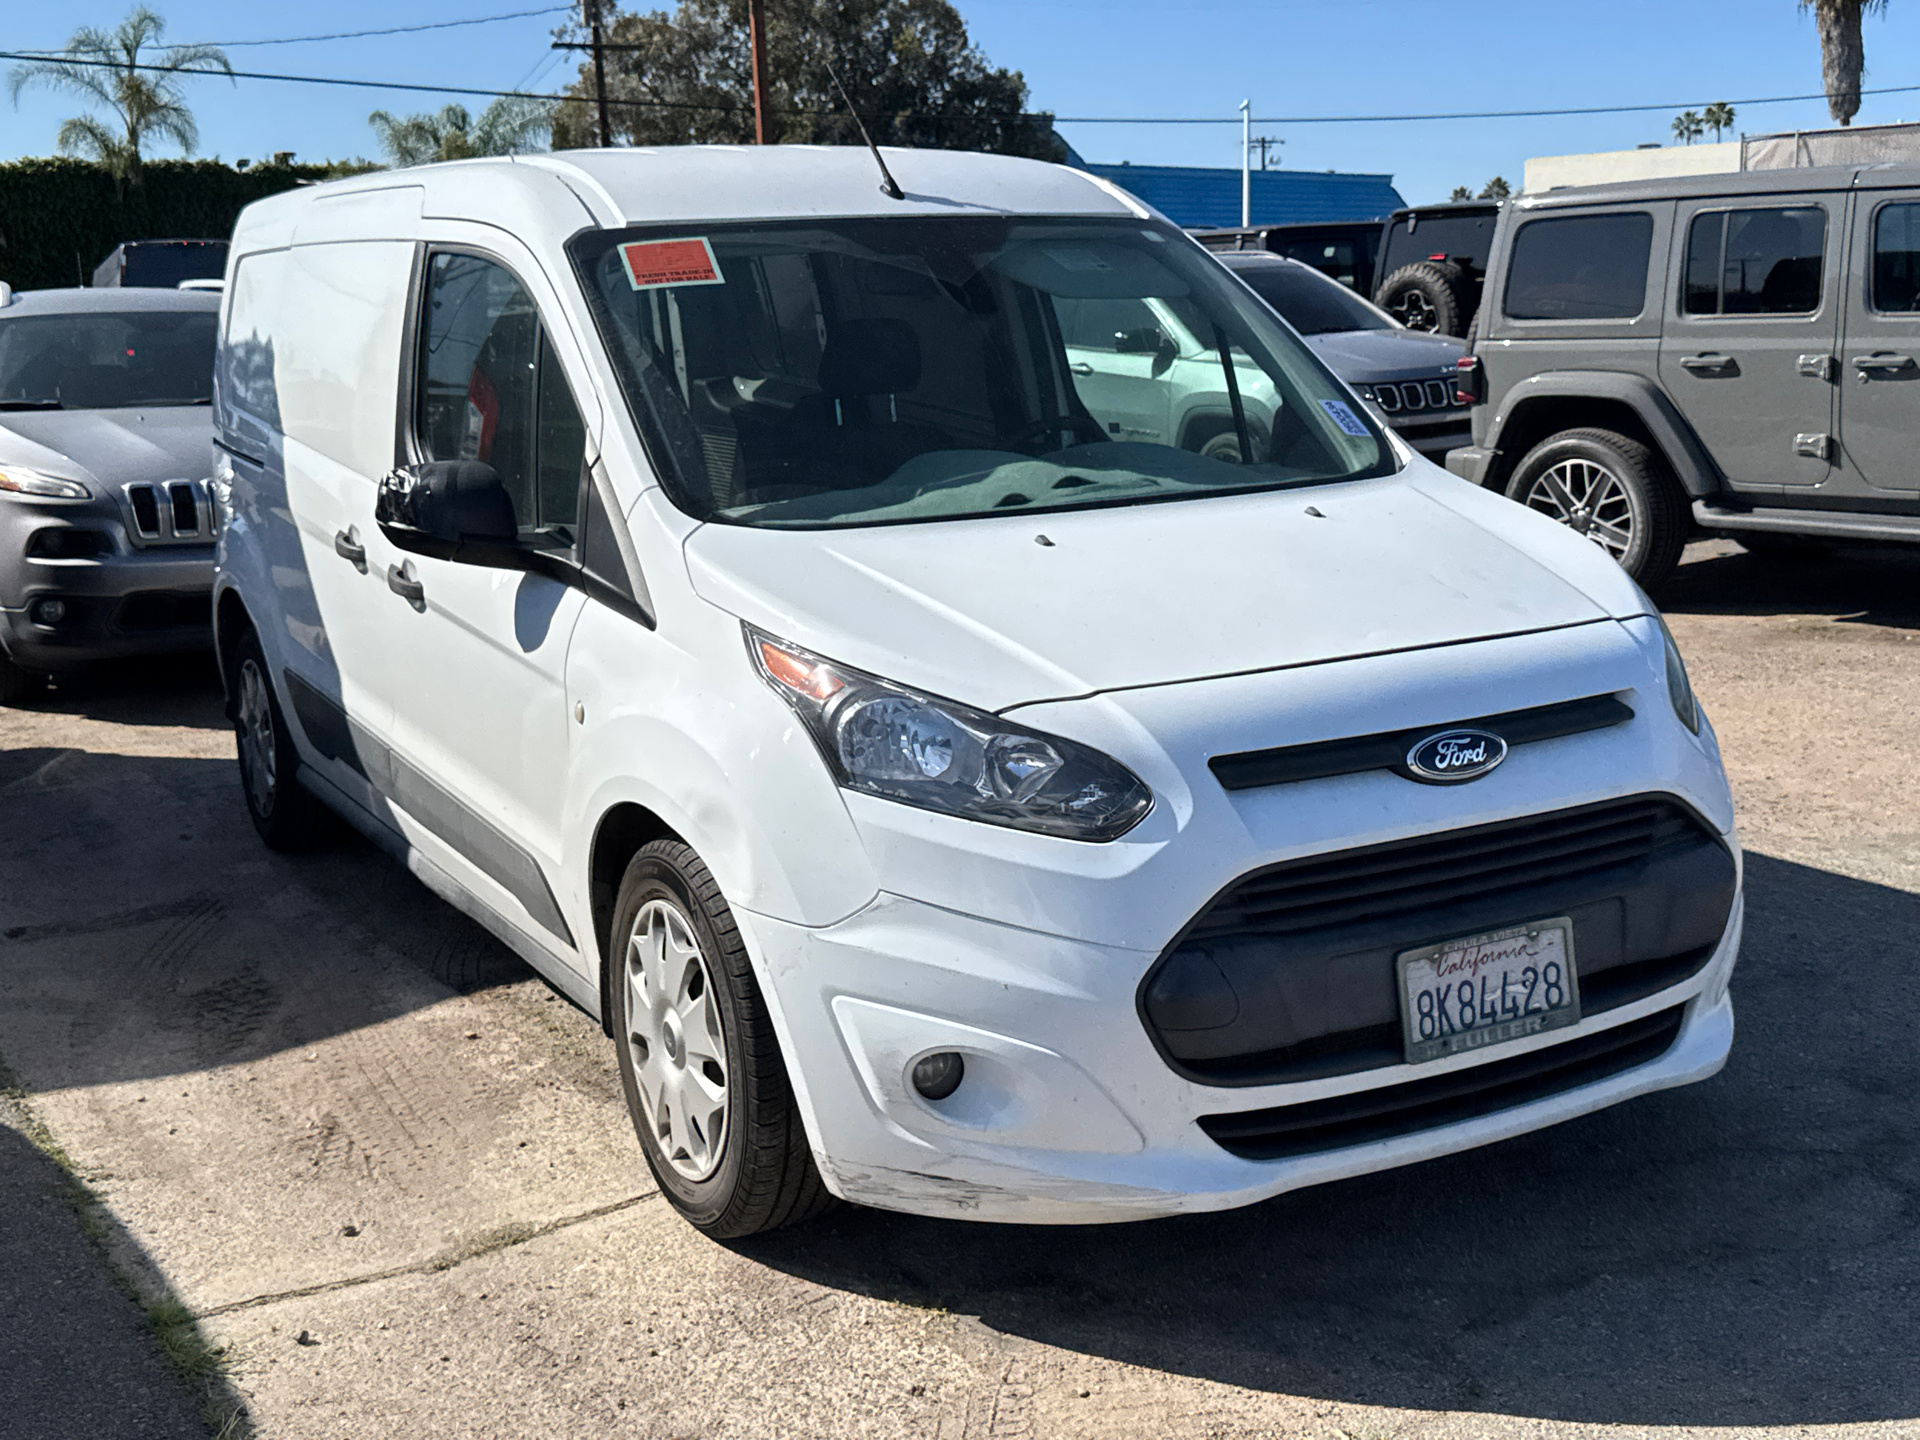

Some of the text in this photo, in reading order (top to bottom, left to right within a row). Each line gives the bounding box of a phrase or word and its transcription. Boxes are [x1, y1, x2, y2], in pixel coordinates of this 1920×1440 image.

[668, 268, 714, 277] TRADE-IN
[1435, 737, 1487, 769] Ford
[1444, 926, 1529, 951] CHULA VISTA
[1436, 943, 1539, 978] California
[1416, 960, 1564, 1041] 8K84428
[1451, 1018, 1543, 1052] FULLER
